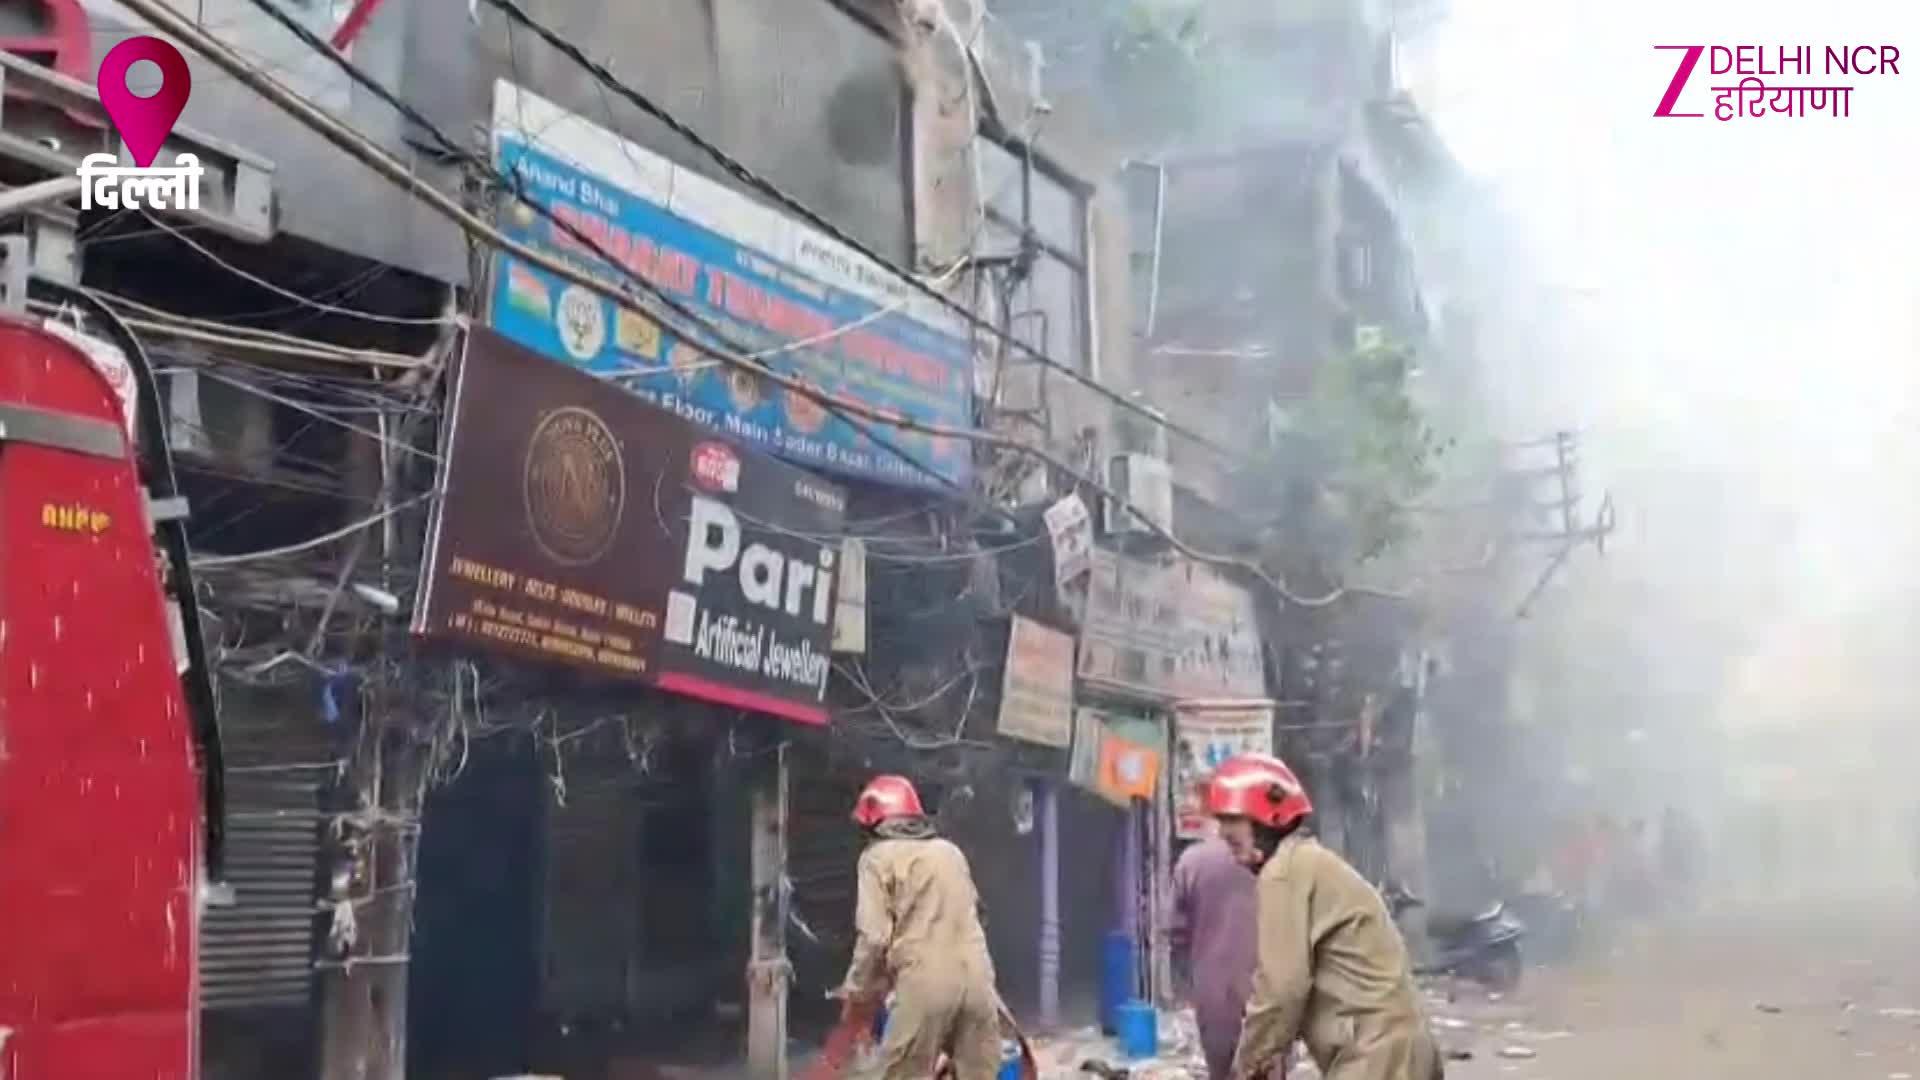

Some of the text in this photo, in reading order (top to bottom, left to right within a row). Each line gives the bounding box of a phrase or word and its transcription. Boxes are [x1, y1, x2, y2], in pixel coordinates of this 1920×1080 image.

[517, 154, 577, 198] Anand
[724, 412, 768, 445] Main
[684, 495, 834, 625] Pari
[695, 607, 765, 672] Artificial
[763, 628, 832, 702] Jewellery
